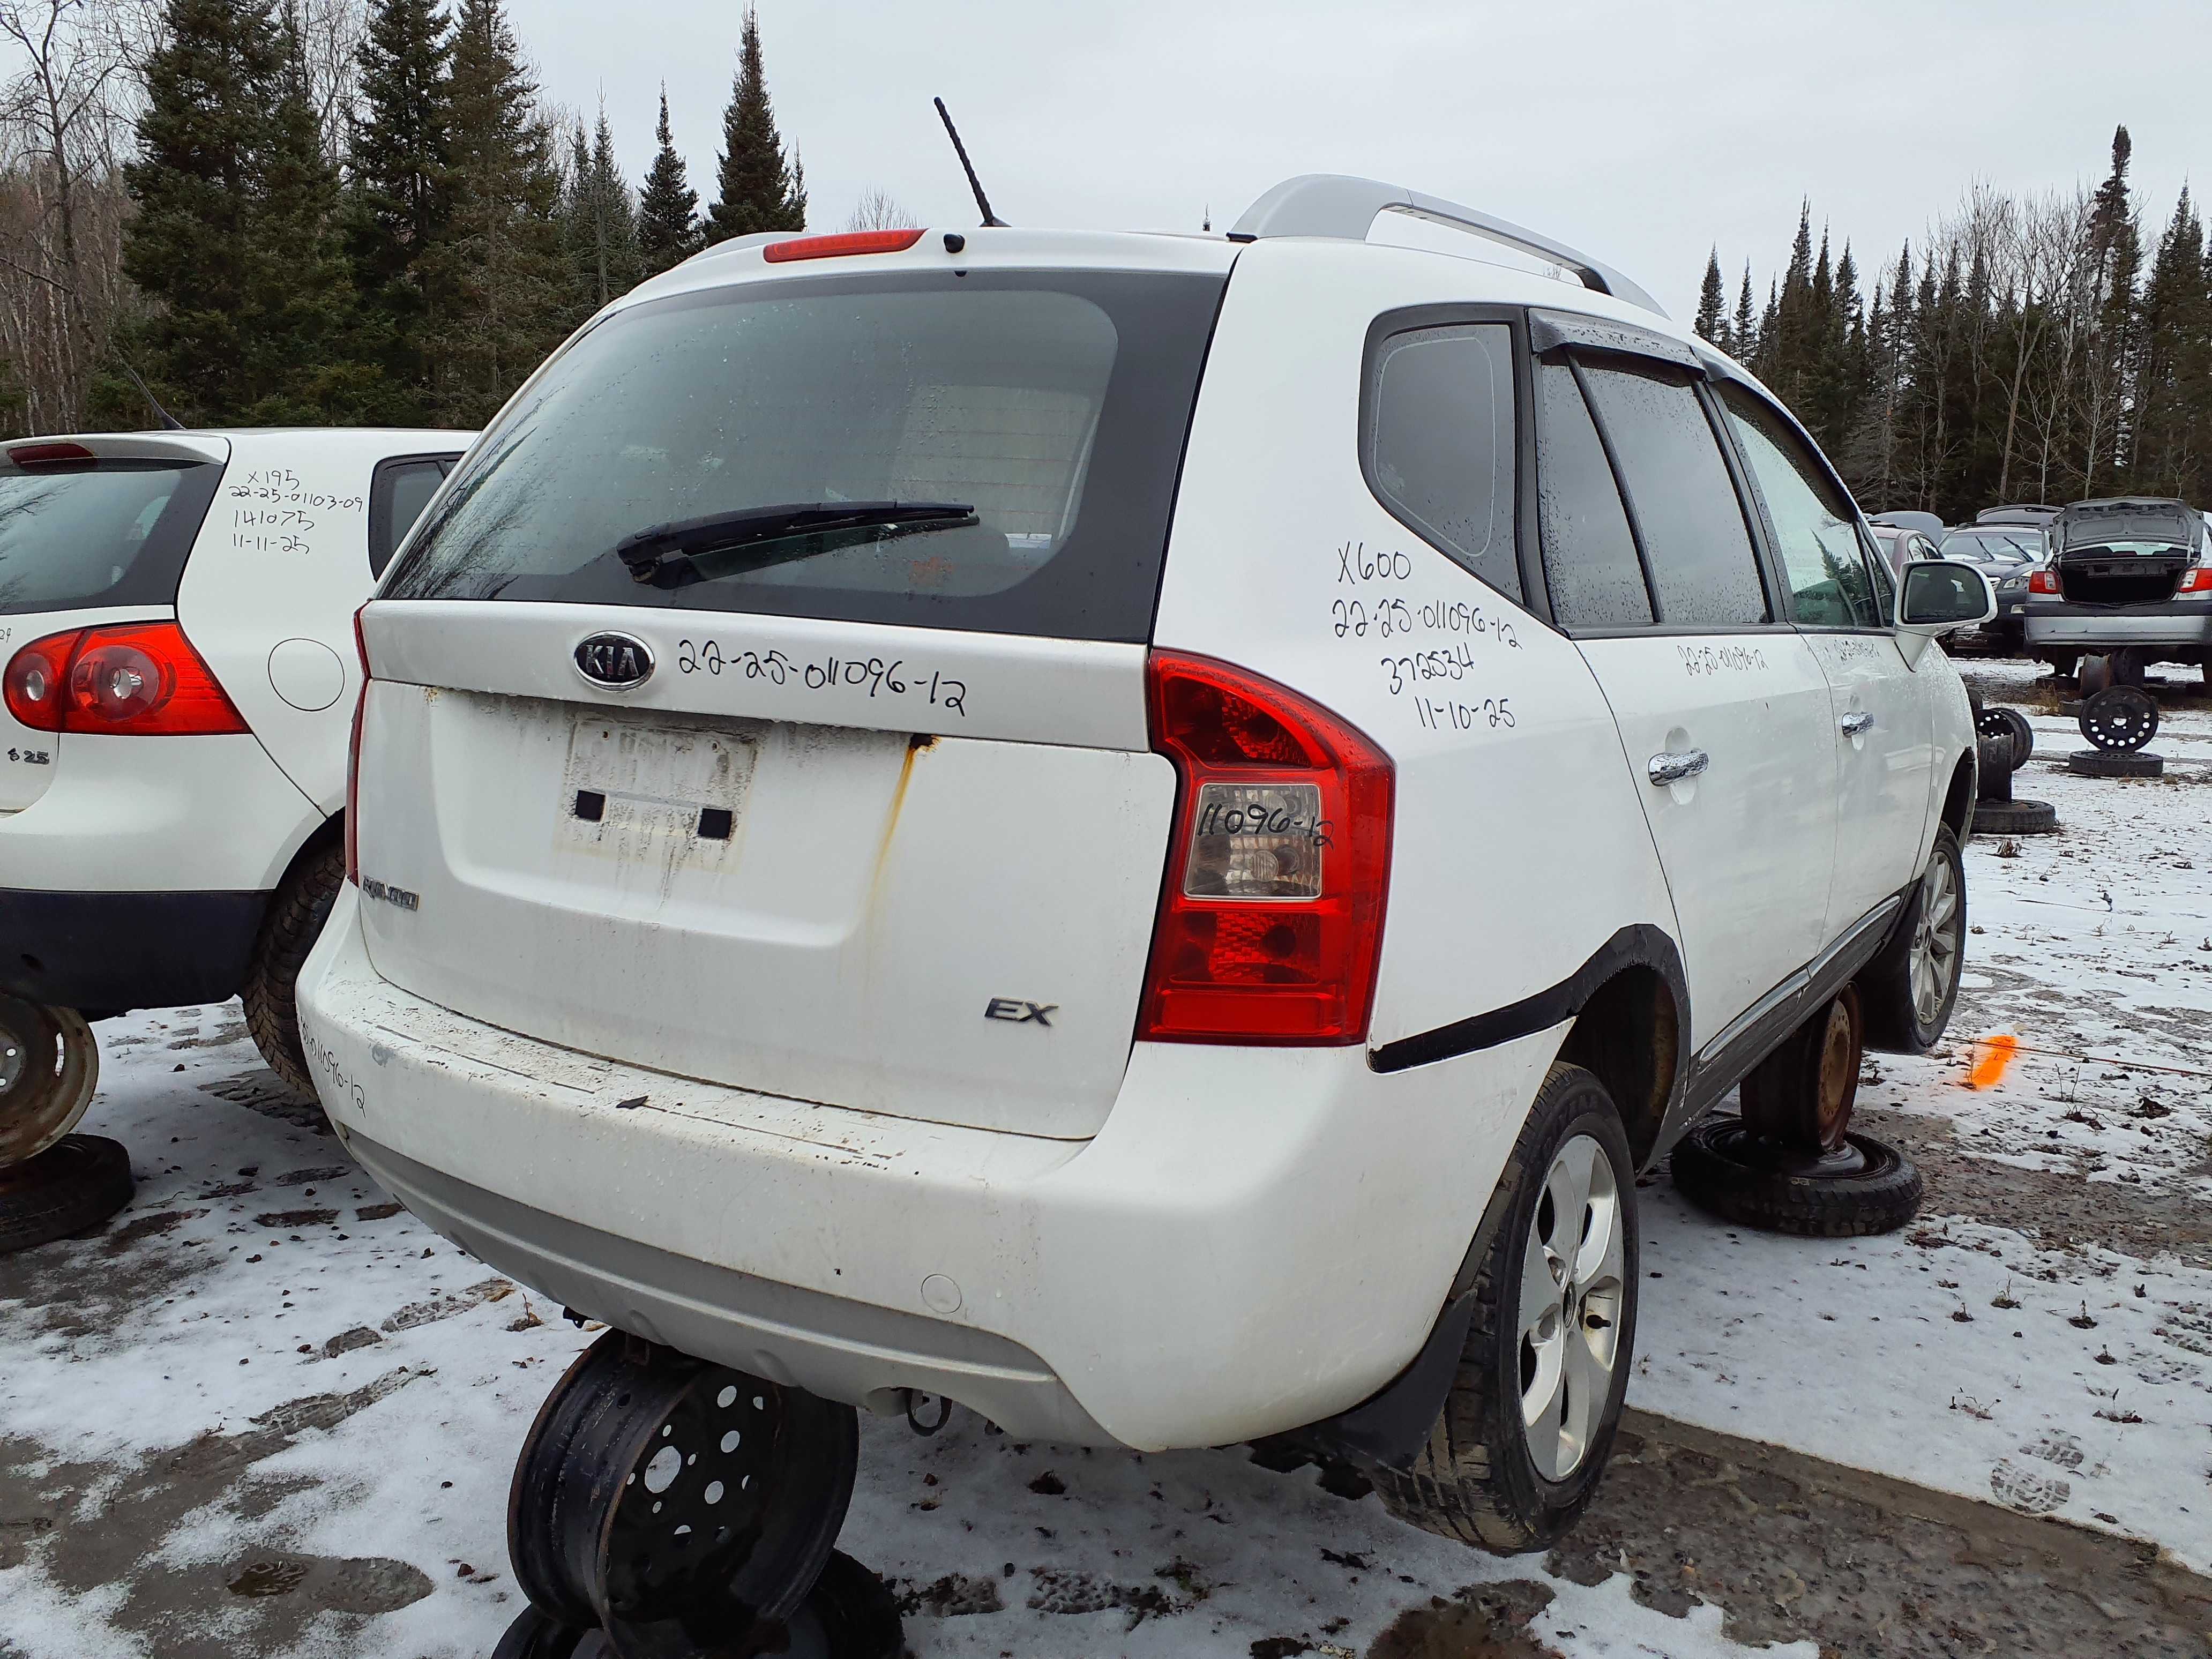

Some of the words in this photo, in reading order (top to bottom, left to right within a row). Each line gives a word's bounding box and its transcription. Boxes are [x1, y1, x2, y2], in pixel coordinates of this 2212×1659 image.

[229, 486, 363, 512] 22-25-01103-09
[235, 510, 315, 531] 141075
[234, 534, 310, 554] 11-11-25
[1338, 541, 1411, 584] X600
[586, 645, 639, 676] KIA
[1381, 642, 1474, 694] 372534
[679, 640, 966, 716] 22-25-011096-12
[1415, 696, 1515, 729] 11-10-25
[1198, 804, 1334, 850] 11096-12
[984, 997, 1059, 1026] EX
